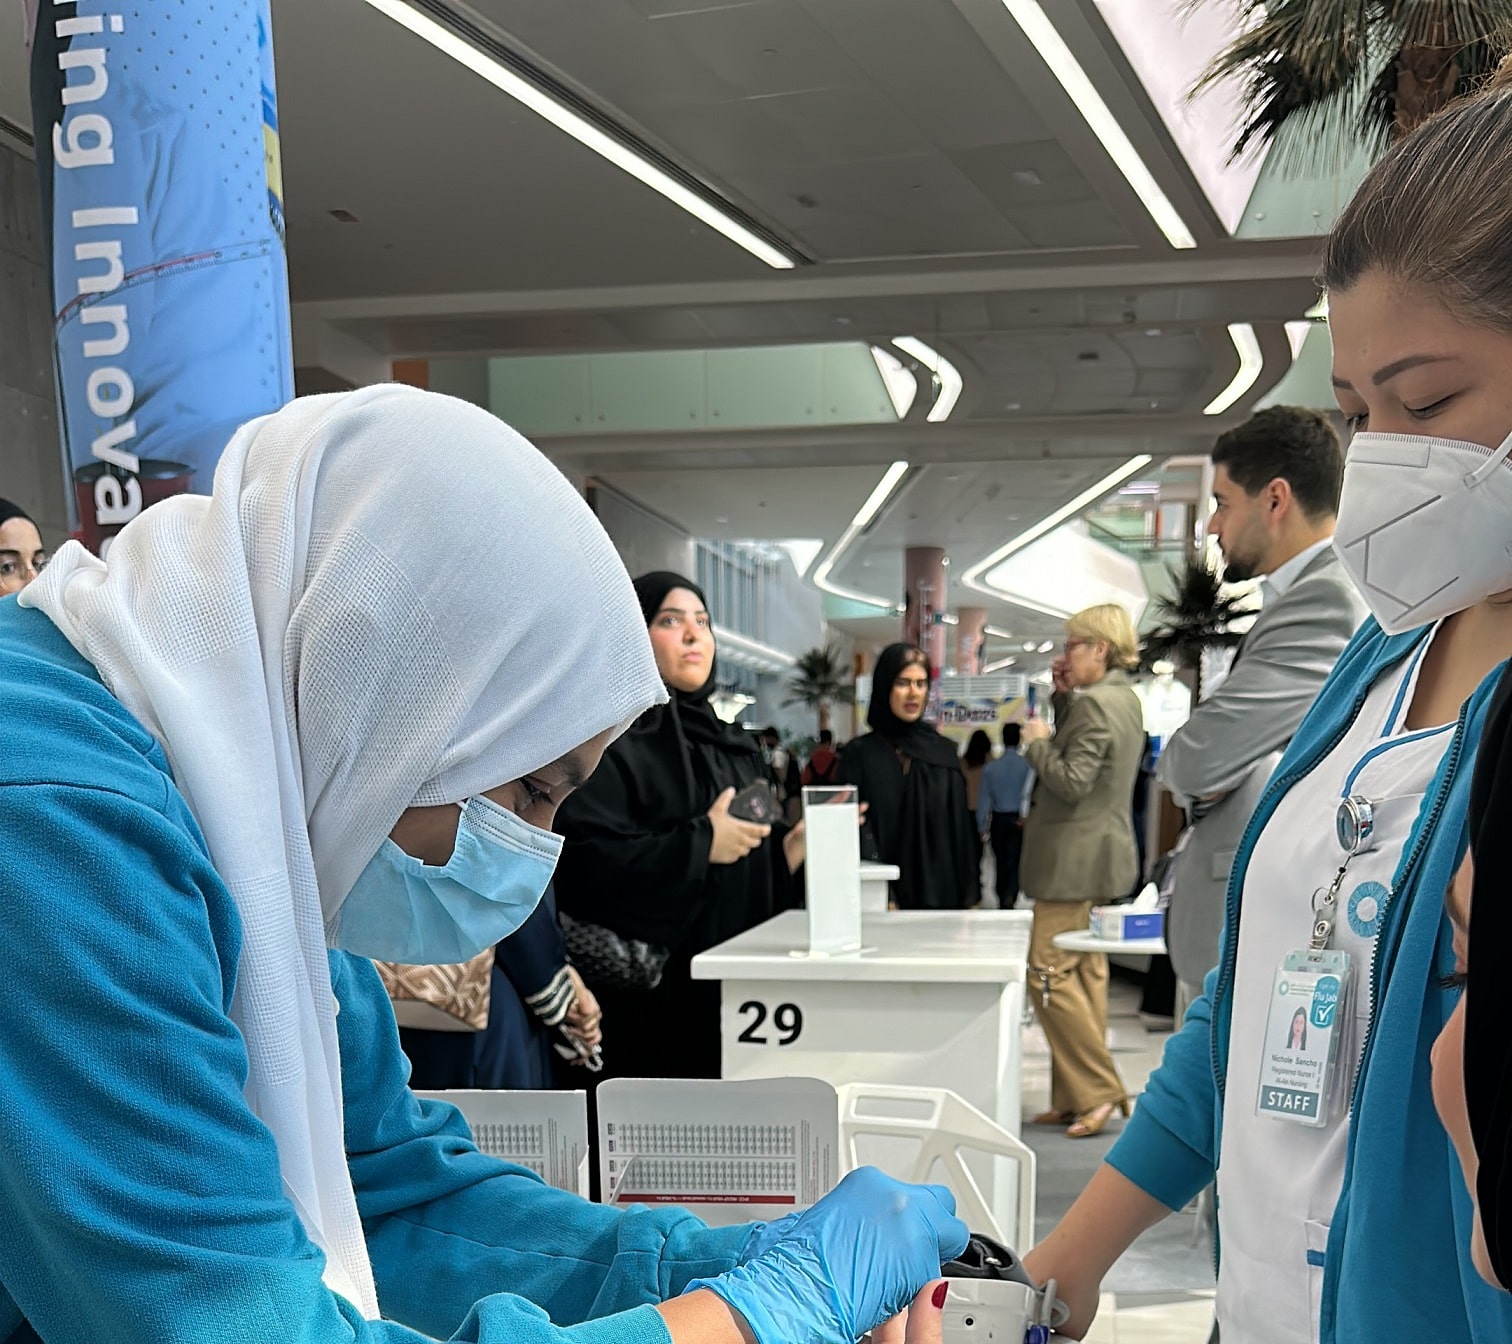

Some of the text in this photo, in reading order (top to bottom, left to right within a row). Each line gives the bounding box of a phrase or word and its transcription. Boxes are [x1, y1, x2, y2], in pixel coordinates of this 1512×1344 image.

[52, 0, 147, 561] ing Innova
[738, 1000, 802, 1046] 29
[1268, 1091, 1311, 1111] STAFF
